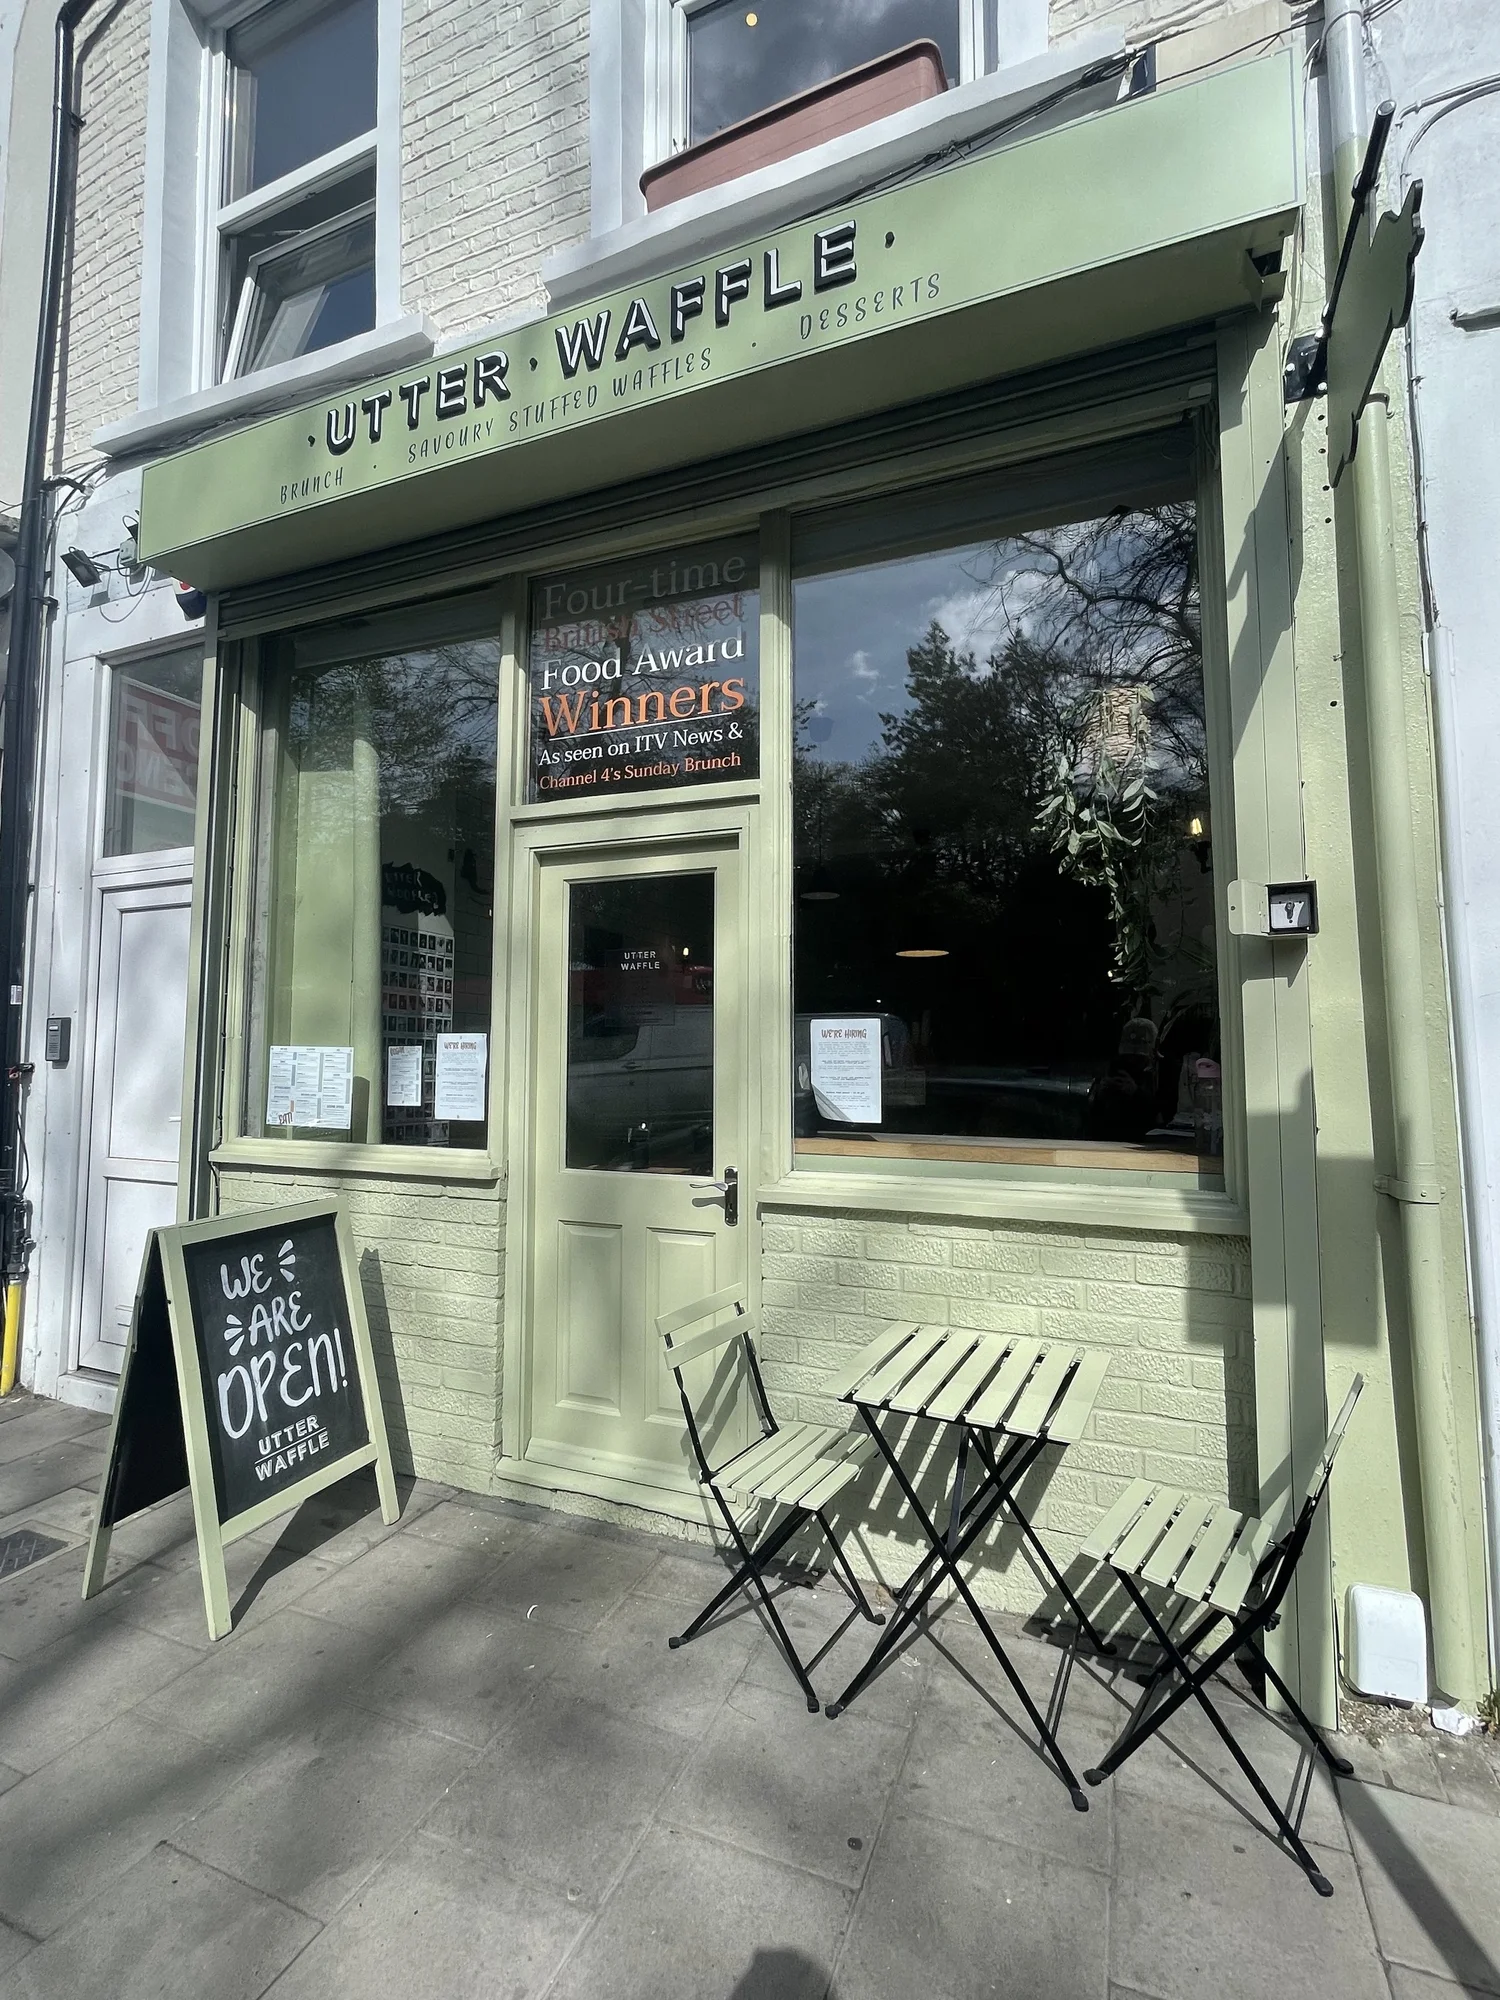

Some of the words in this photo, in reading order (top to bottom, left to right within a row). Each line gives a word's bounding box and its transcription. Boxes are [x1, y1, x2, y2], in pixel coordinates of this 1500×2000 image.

[326, 350, 511, 456] UTTER
[554, 219, 857, 380] WAFFLE
[279, 466, 344, 505] BRUNCH
[408, 417, 495, 464] SAVOURY
[509, 384, 598, 432] STUFFED
[612, 346, 712, 398] WAFFLES
[799, 272, 942, 341] DESSERTS
[542, 555, 747, 621] Four-time
[649, 594, 746, 635] Street
[540, 647, 623, 691] Food
[631, 624, 745, 676] Award
[538, 677, 746, 738] Winners
[538, 749, 561, 766] As
[564, 745, 604, 764] seen
[607, 740, 631, 757] on
[634, 732, 668, 753] ITV
[672, 727, 723, 748] News
[727, 721, 744, 740] &
[539, 768, 598, 790] Channel
[600, 766, 622, 782] 4's
[624, 760, 680, 780] Sunday
[684, 752, 742, 772] Brunch
[620, 961, 660, 971] WAFFLE
[624, 950, 656, 960] UTTER
[821, 1028, 842, 1039] WE'RE
[844, 1028, 867, 1039] HIRING
[220, 1253, 273, 1300] WE
[248, 1290, 312, 1346] ARE
[217, 1327, 348, 1440] OPEN!
[254, 1430, 330, 1482] WAFFLE
[258, 1413, 320, 1456] UTTER
